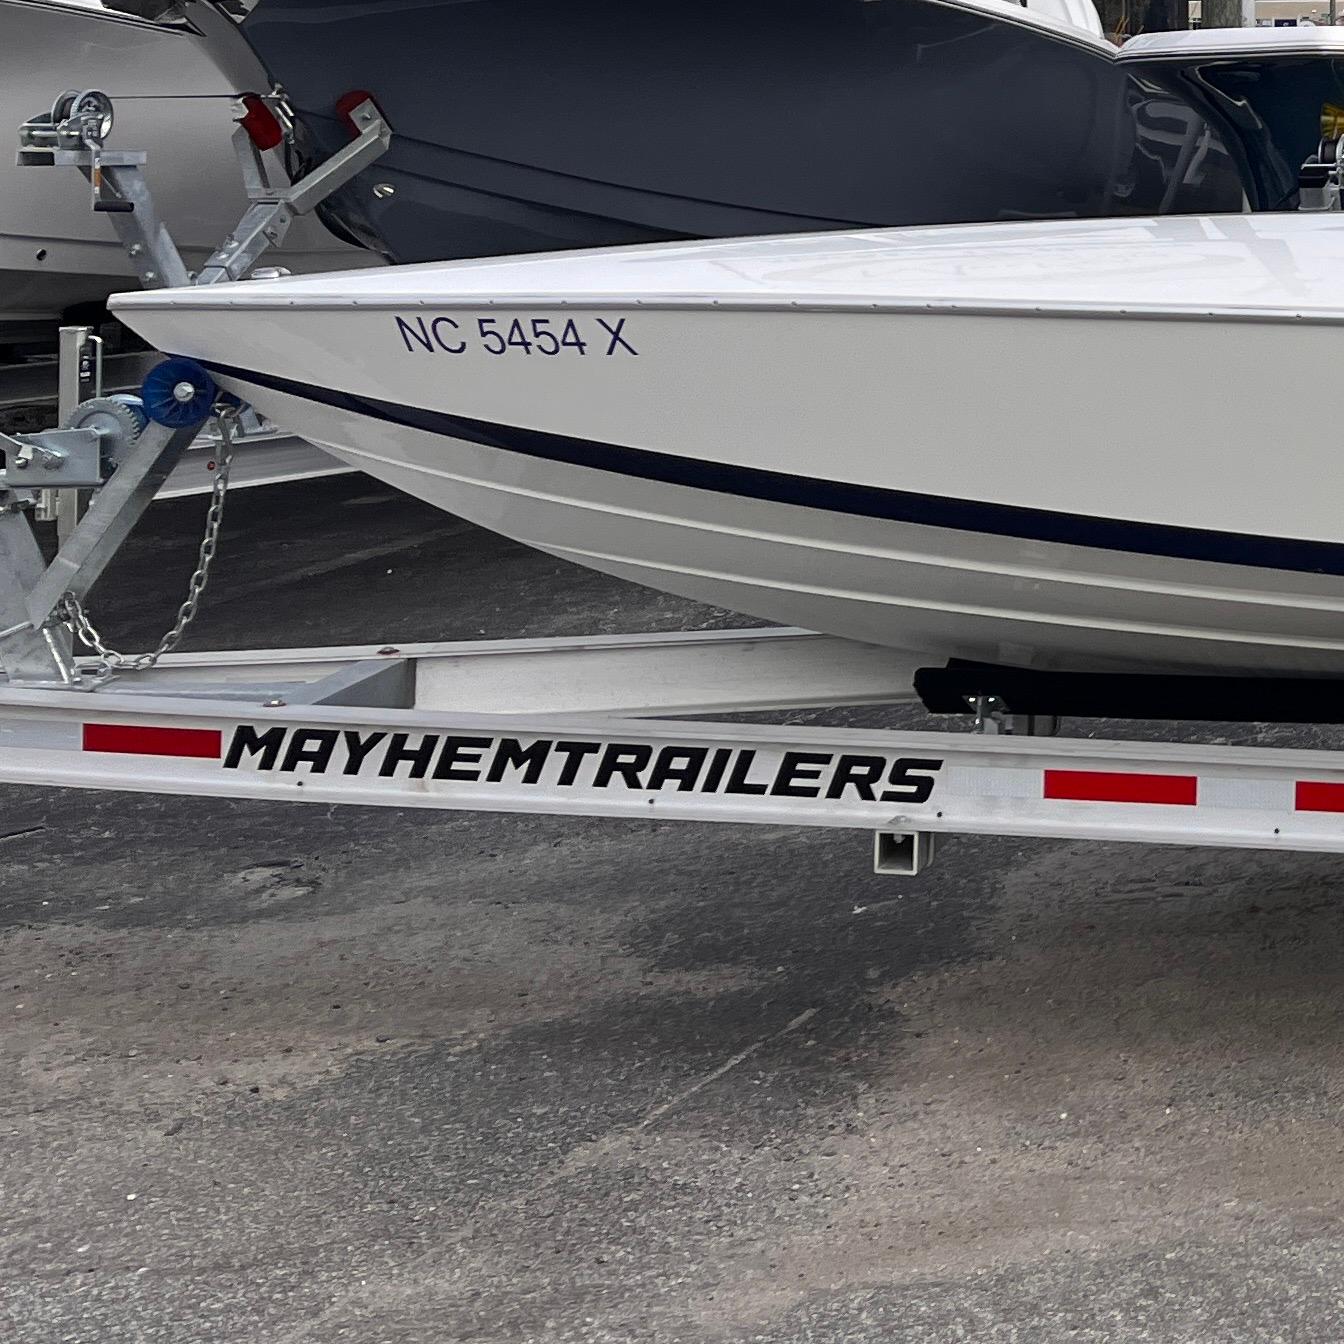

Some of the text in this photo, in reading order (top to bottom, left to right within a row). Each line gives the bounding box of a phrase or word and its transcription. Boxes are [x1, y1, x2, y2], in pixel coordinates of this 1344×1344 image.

[395, 315, 639, 356] NC 5454 X
[223, 724, 944, 804] MAYHEMTRAILERS
